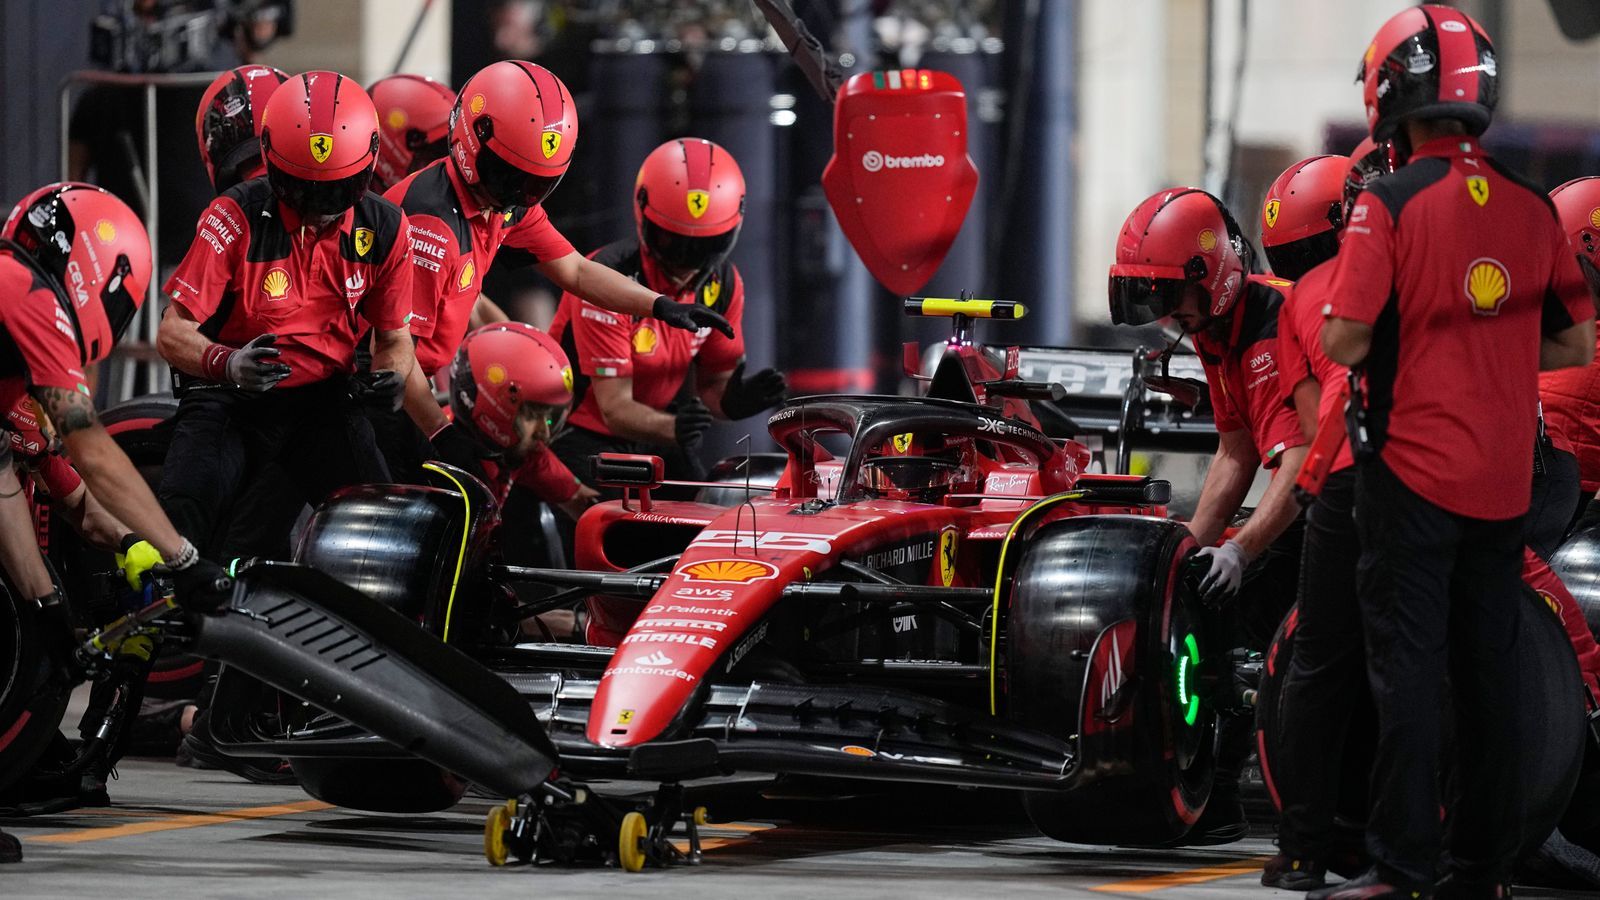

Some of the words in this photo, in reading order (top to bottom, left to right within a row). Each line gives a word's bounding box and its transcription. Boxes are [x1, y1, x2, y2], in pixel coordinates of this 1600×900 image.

[456, 141, 474, 182] CEVA
[885, 154, 945, 169] brembo
[206, 214, 235, 245] MAHLE
[214, 204, 243, 236] Bitdefender
[200, 228, 224, 254] PIRELLI
[68, 261, 89, 307] CEVA
[1213, 275, 1234, 315] CEVA
[1249, 351, 1272, 369] aws
[977, 416, 1007, 435] DXC
[1008, 425, 1040, 440] TECHNOL
[685, 530, 838, 555] 55
[867, 547, 906, 570] RICHARD
[906, 541, 933, 563] MILLE
[675, 586, 735, 597] aws
[666, 605, 738, 617] Palantir
[633, 619, 727, 632] PIRELLI
[623, 632, 718, 649] MAHLE
